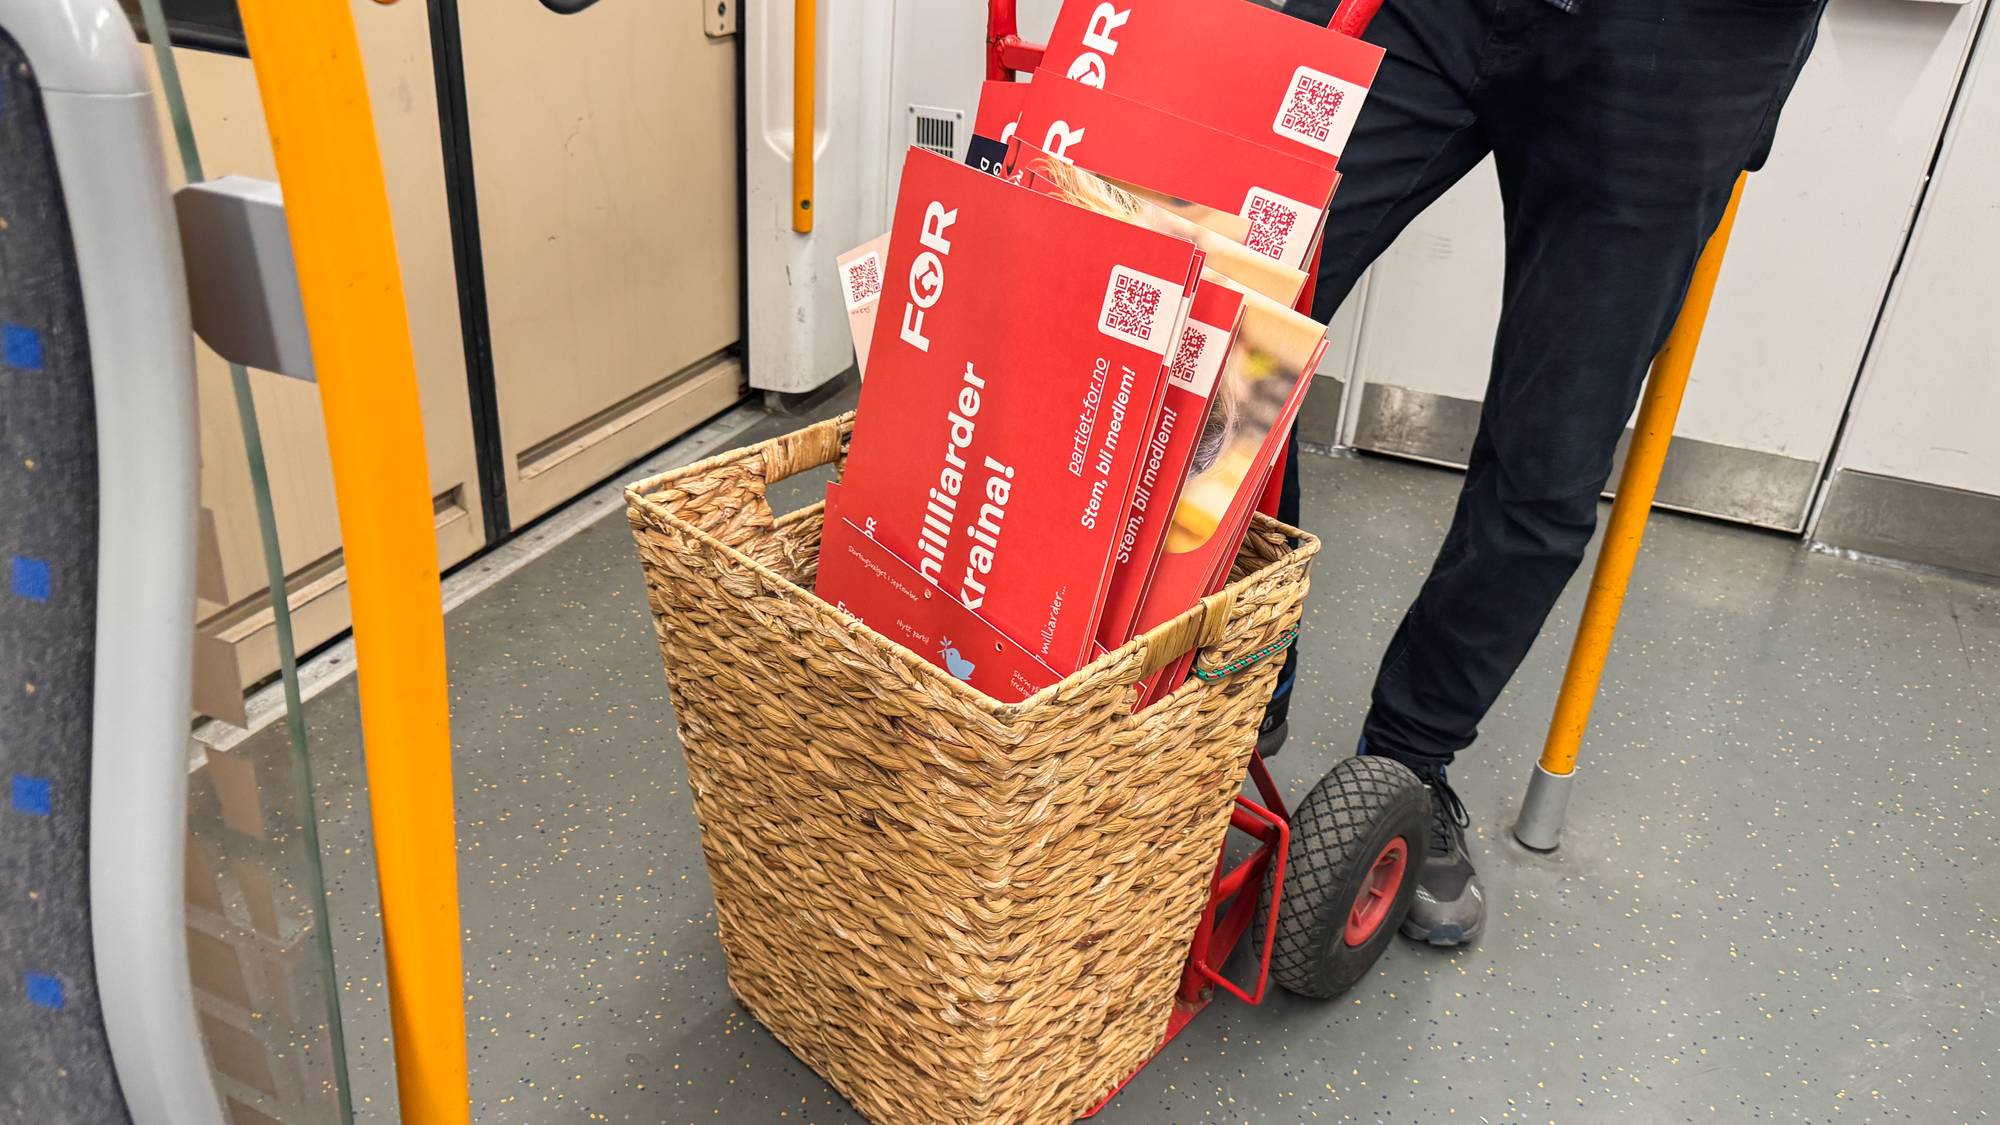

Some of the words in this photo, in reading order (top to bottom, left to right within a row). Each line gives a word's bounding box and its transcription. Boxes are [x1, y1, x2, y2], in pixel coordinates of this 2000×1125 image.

[1066, 2, 1132, 90] OR
[900, 200, 958, 353] FOR
[1068, 357, 1109, 477] partiet-for.no
[1081, 478, 1109, 530] Stem,
[1095, 449, 1113, 478] bli
[1105, 366, 1137, 451] medlem!
[1116, 515, 1144, 564] Stem,
[1132, 486, 1150, 513] bli
[1142, 406, 1178, 485] medlem!
